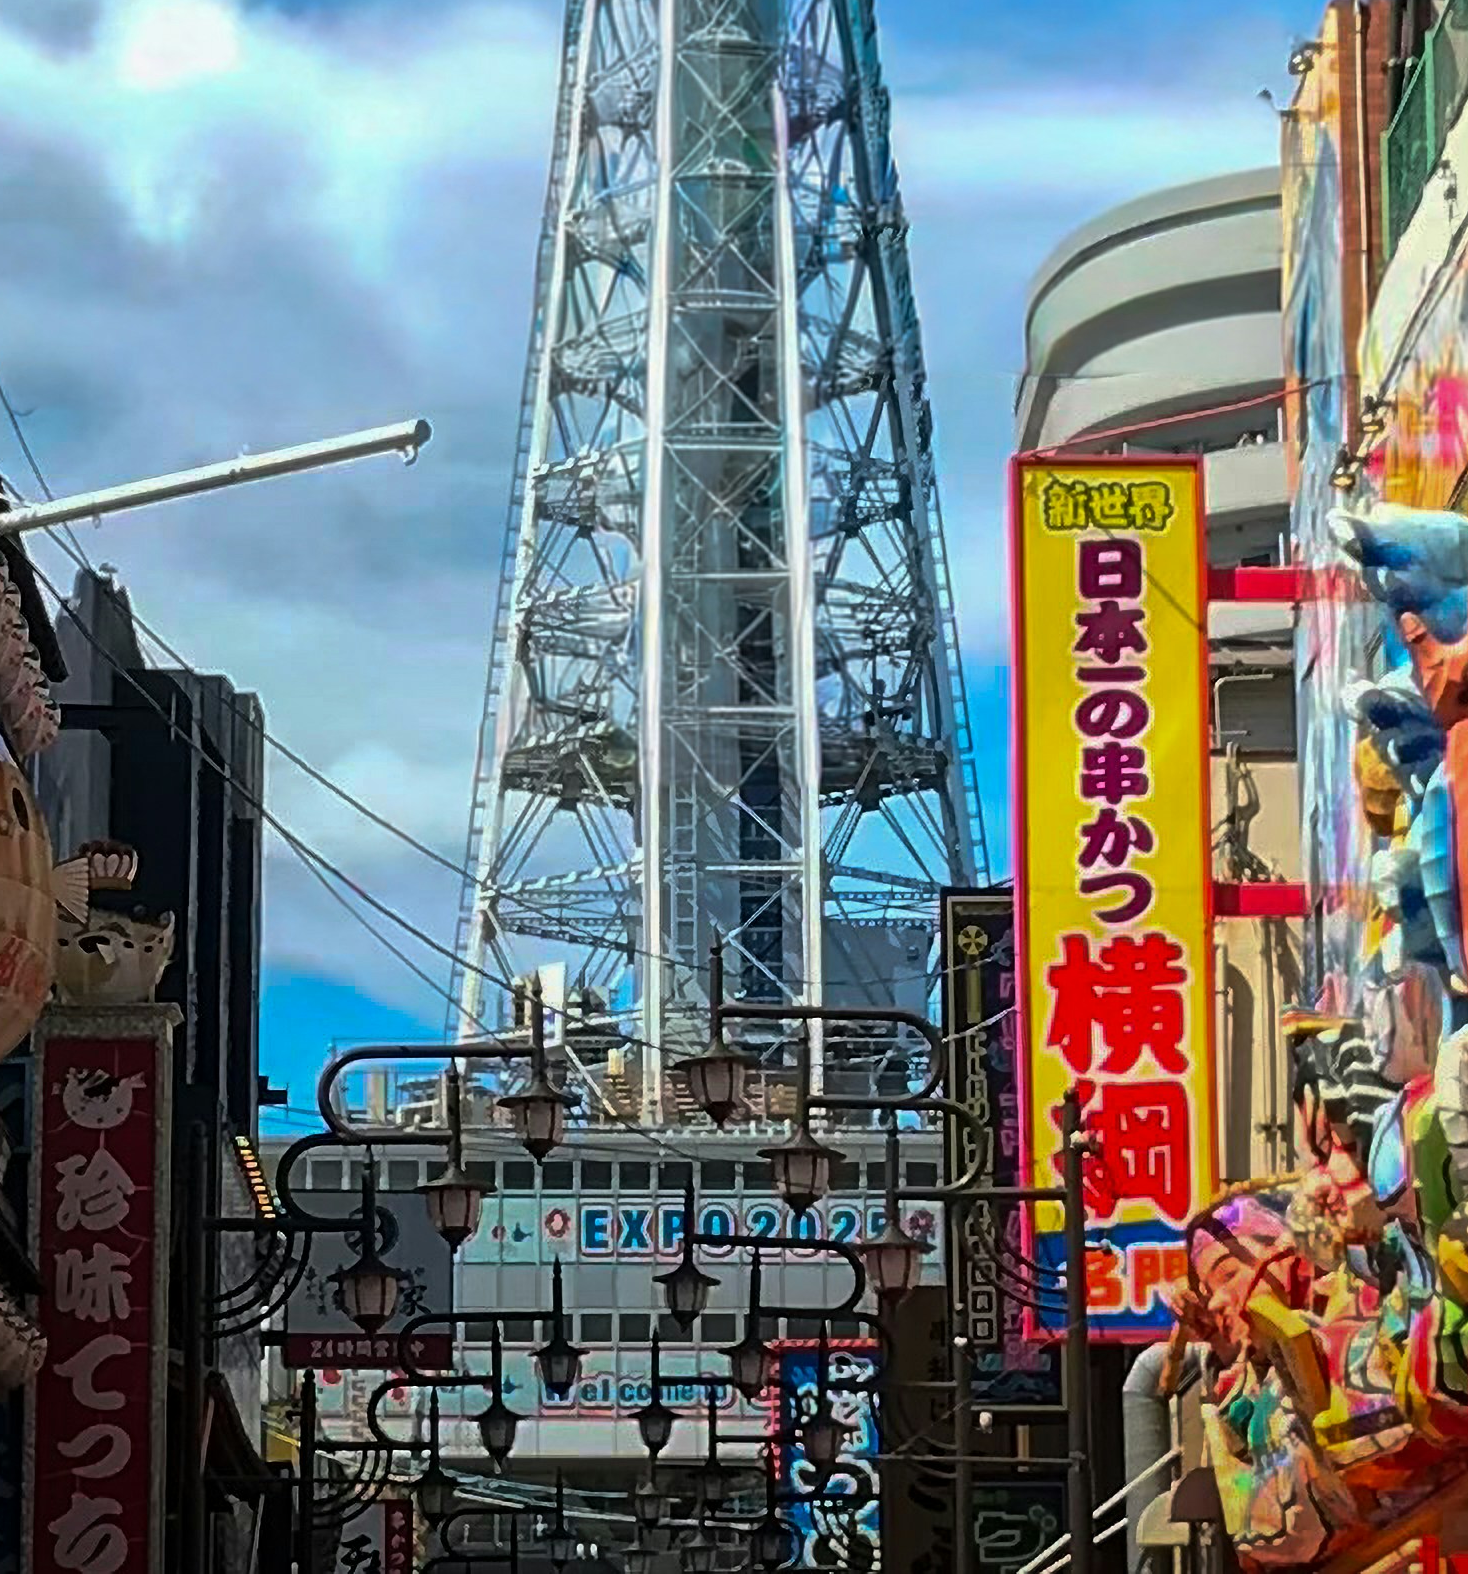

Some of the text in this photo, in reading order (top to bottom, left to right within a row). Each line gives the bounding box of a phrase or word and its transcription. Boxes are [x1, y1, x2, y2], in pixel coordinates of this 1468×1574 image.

[1043, 480, 1172, 531] 新世界
[1073, 539, 1155, 924] 日本一の串かつ
[1045, 933, 1195, 1223] 横綱
[583, 1206, 733, 1254] EXPO
[48, 1148, 136, 1574] 珍味てっち
[309, 1338, 426, 1358] 24時間営中
[545, 1376, 695, 1403] elcome
